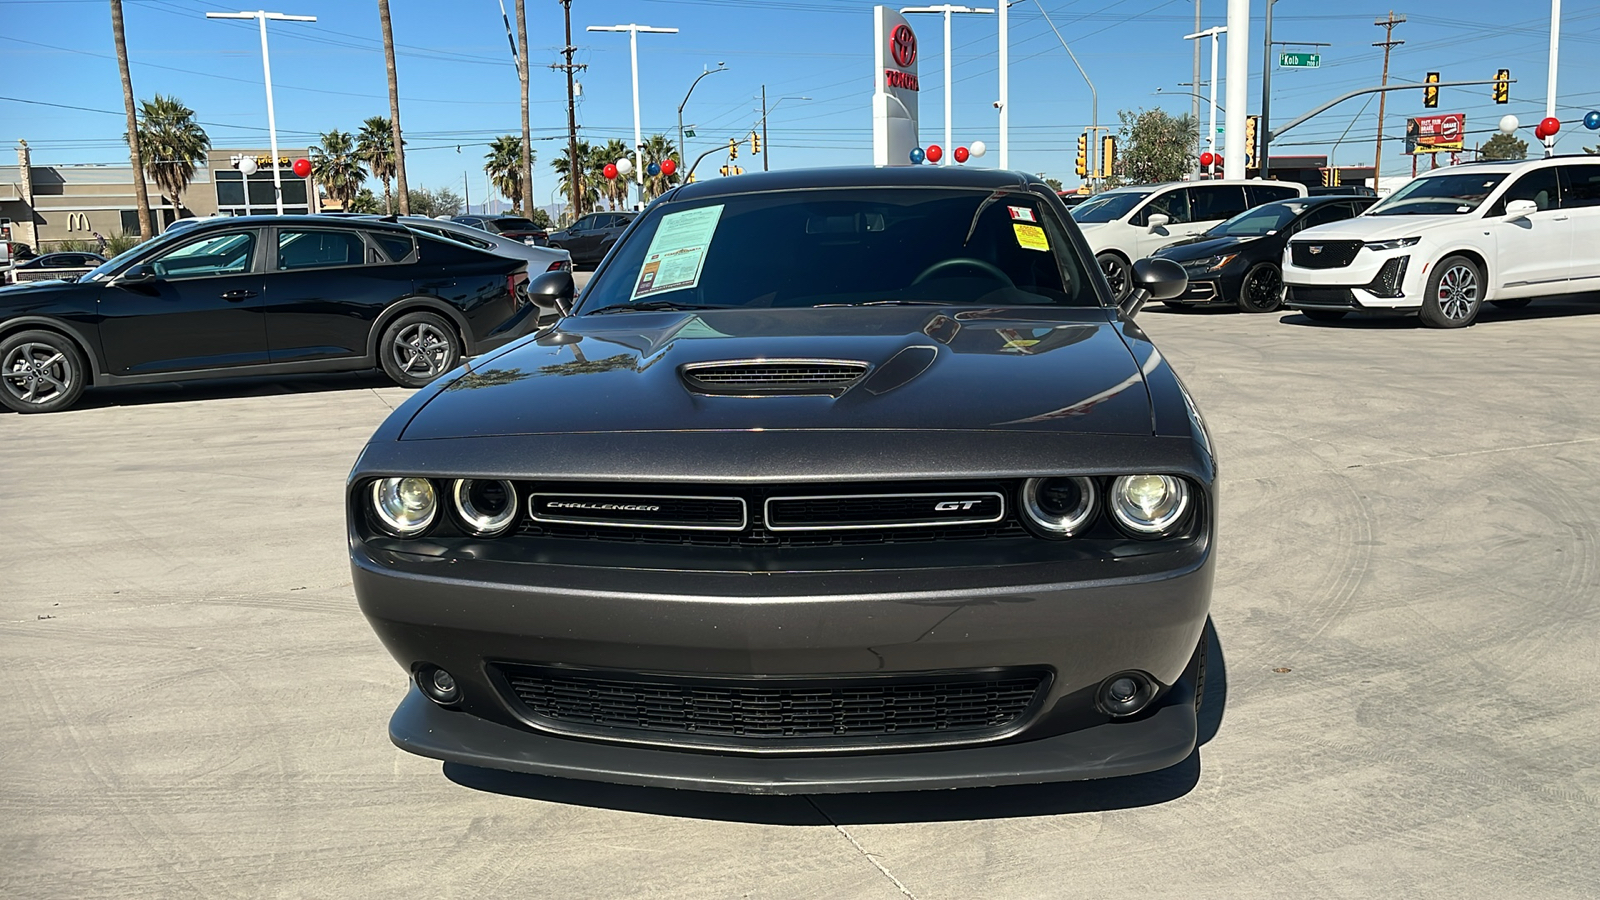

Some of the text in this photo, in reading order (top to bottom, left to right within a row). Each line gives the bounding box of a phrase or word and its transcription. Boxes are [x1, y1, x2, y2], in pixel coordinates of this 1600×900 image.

[1284, 55, 1299, 65] Kolb
[885, 70, 919, 91] TOYOTA
[547, 501, 660, 512] CHALLENGER
[934, 500, 982, 511] GT
